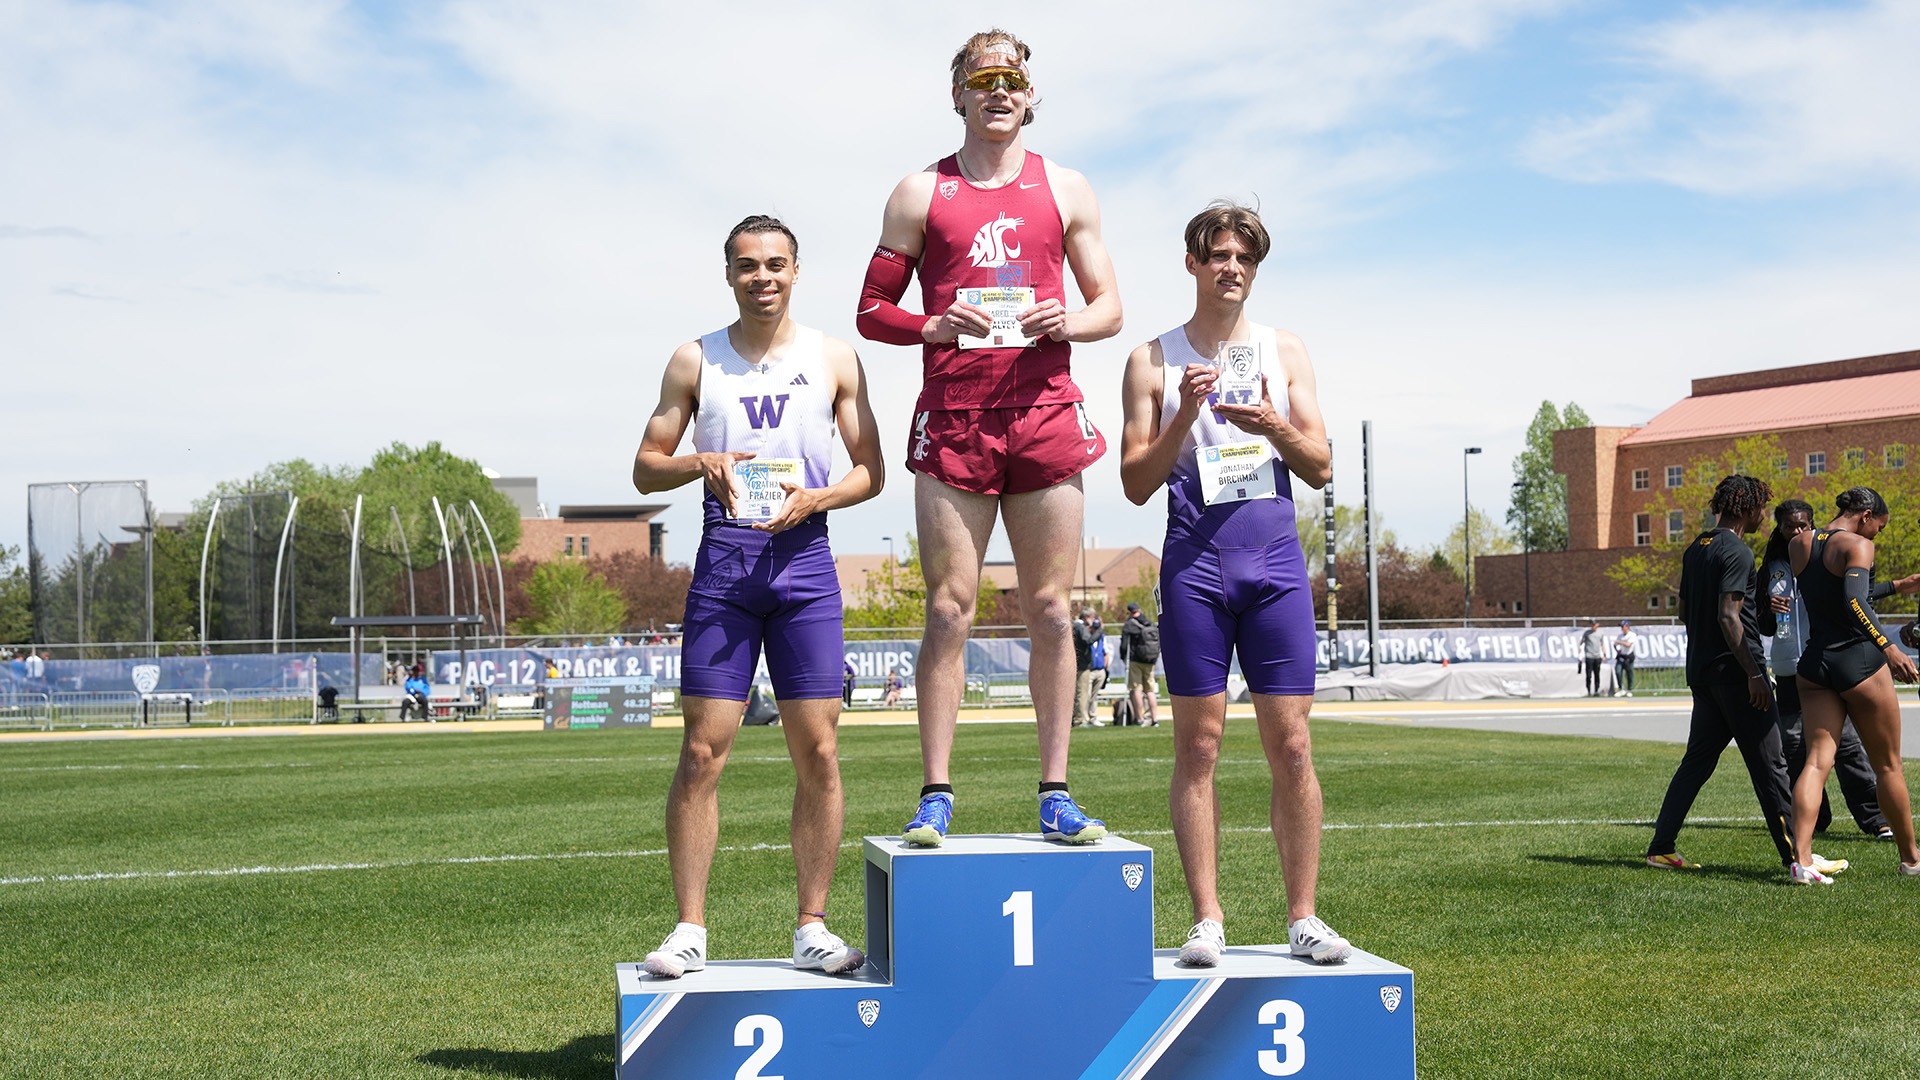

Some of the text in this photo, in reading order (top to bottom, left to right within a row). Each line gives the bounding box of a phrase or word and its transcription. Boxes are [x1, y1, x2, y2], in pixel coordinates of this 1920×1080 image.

[739, 393, 790, 430] W
[1220, 463, 1255, 475] JONATHAN
[1218, 473, 1259, 486] BIRCHMAN
[749, 491, 782, 501] FRAZIER
[1850, 597, 1881, 639] PROTECT THE
[1378, 637, 1450, 663] TRACK
[1455, 637, 1472, 660] &
[1477, 635, 1541, 660] FIELD
[448, 660, 537, 688] PAC-12
[626, 656, 643, 677] &
[545, 715, 552, 724] 6
[1128, 877, 1138, 886] 12
[1002, 890, 1034, 967] 1
[1387, 999, 1396, 1008] 12
[864, 1013, 874, 1023] 12
[733, 1014, 785, 1080] 2
[1257, 1000, 1306, 1076] 3
